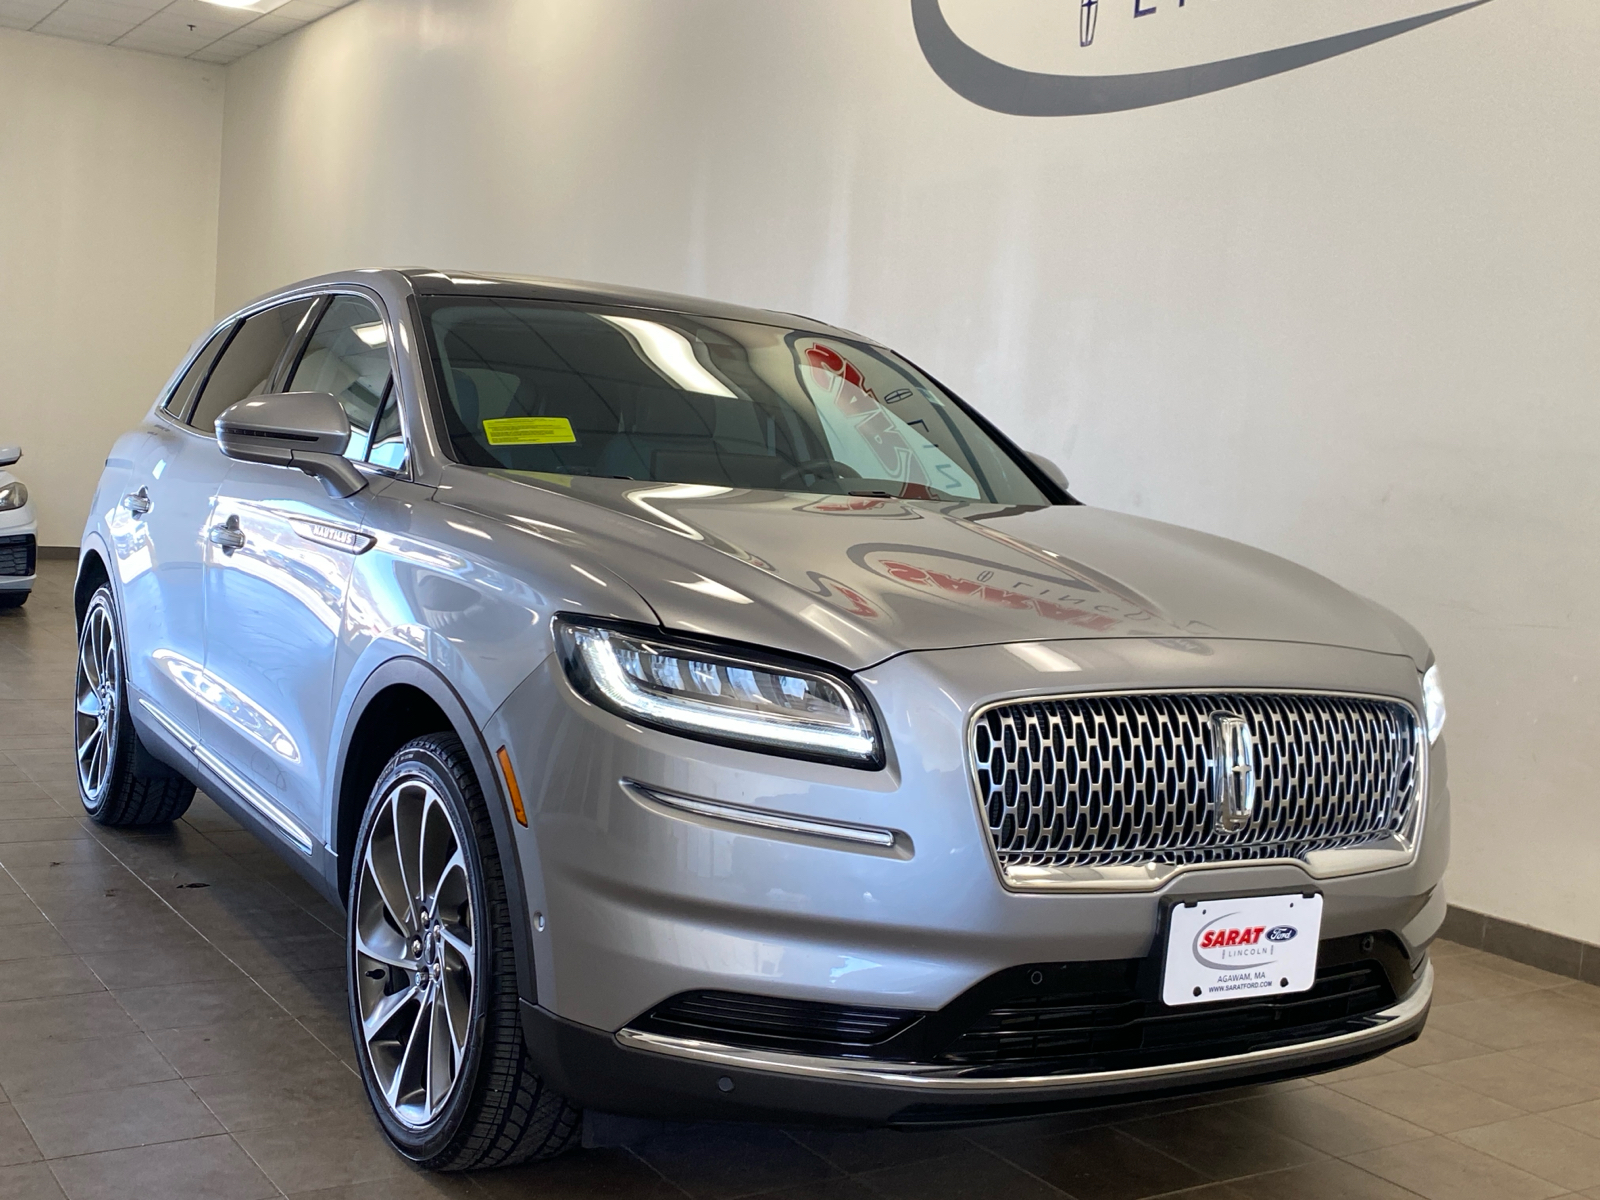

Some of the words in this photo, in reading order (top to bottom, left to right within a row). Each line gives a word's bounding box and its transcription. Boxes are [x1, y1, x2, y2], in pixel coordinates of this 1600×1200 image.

[313, 524, 353, 543] NAUTILUS
[1200, 926, 1266, 949] SARAT
[1270, 928, 1292, 940] Ford
[1228, 947, 1267, 957] LINCOLN
[1217, 973, 1253, 983] AGAWAM,
[1254, 972, 1266, 980] MA
[1208, 981, 1272, 993] WWW.SARATFORD.COM
